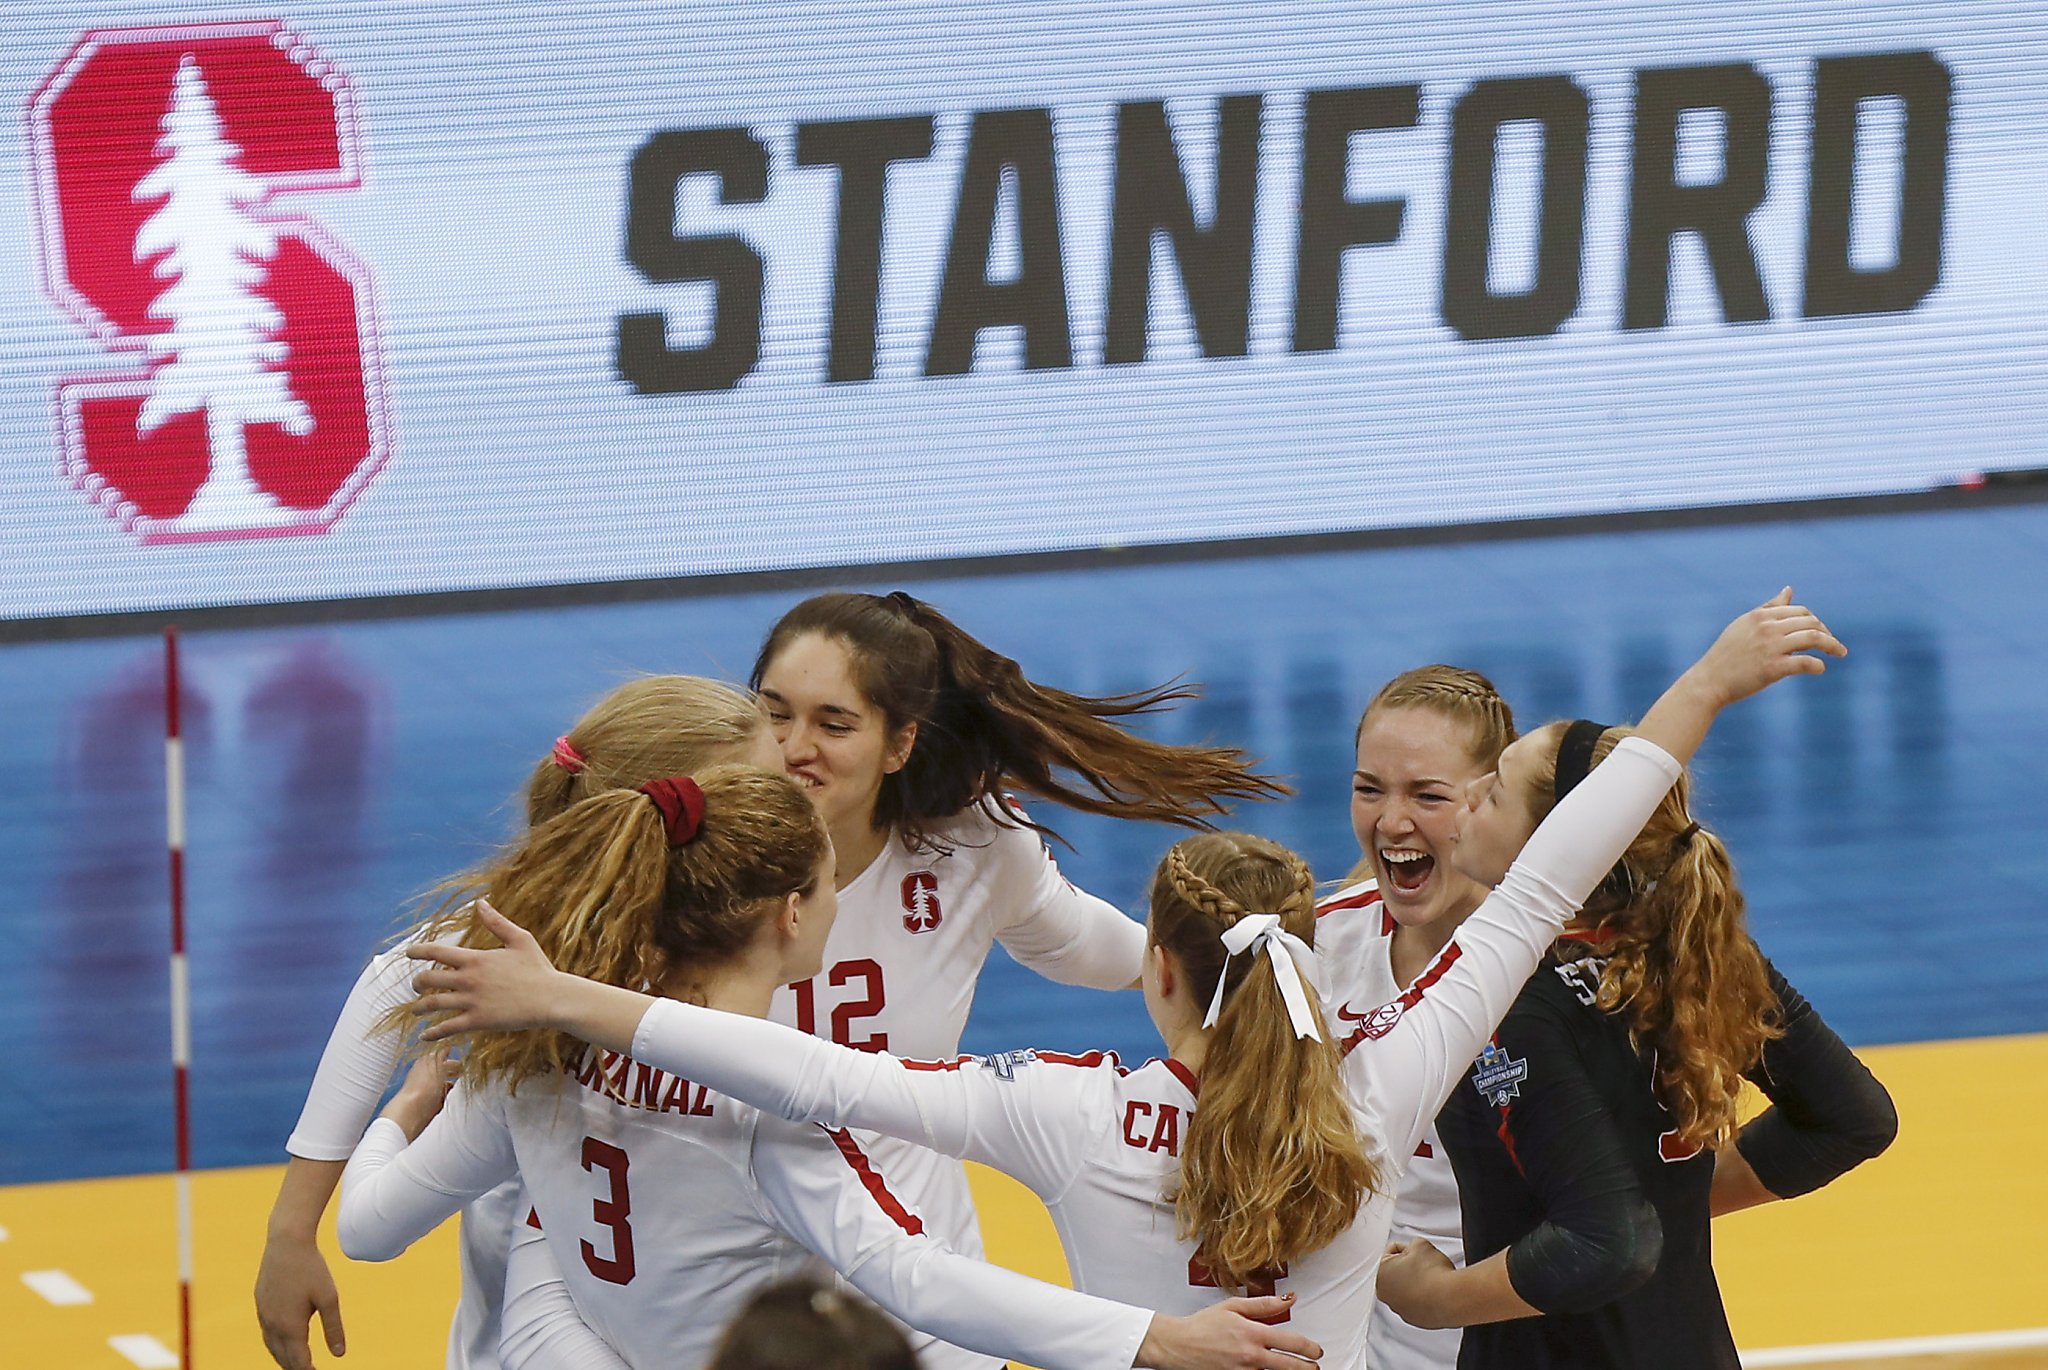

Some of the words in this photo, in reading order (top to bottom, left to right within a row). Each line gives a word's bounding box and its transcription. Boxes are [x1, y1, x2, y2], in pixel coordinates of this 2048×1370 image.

[613, 47, 1955, 396] STANFORD
[788, 957, 889, 1056] 12
[579, 1135, 636, 1287] 3
